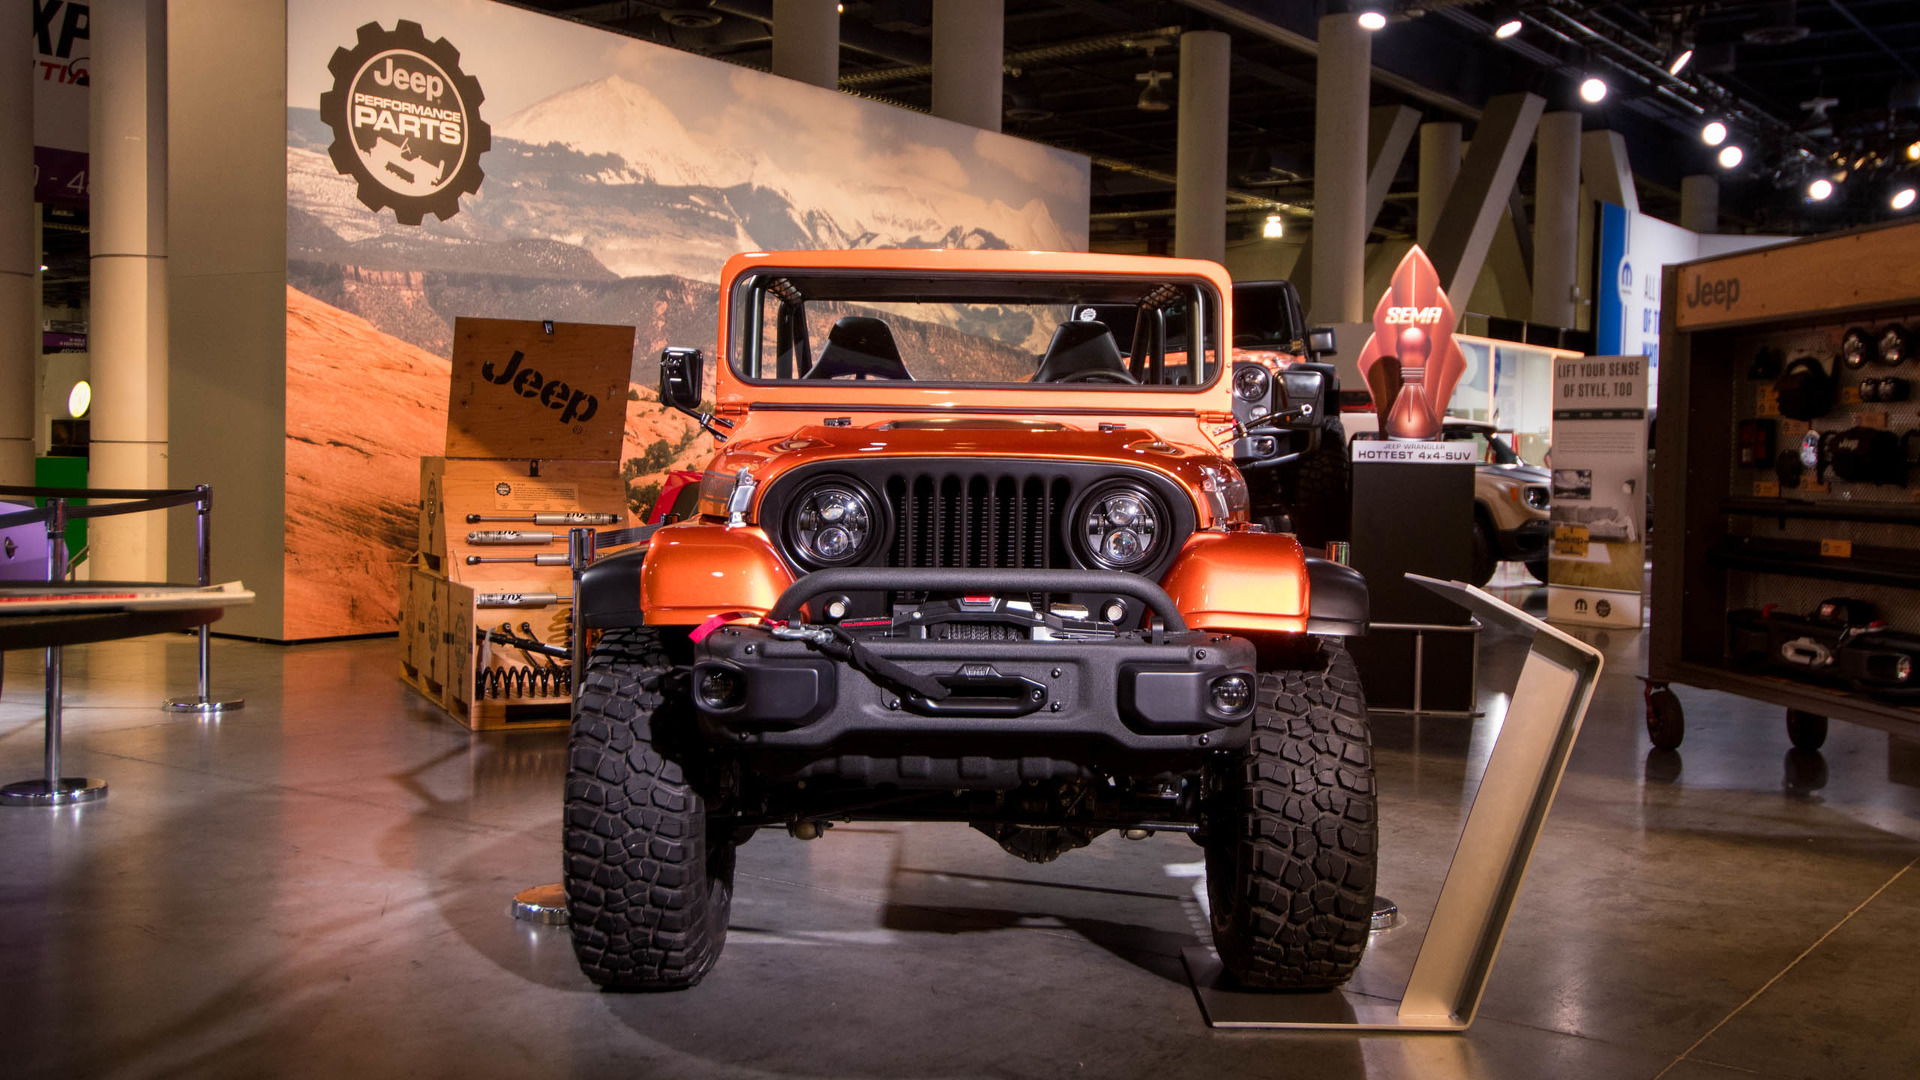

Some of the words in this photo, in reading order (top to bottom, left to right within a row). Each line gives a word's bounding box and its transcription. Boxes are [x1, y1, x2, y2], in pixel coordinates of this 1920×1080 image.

[374, 58, 444, 101] Jeep
[354, 92, 461, 123] PERFORMANCE
[354, 104, 461, 146] PARTS
[1686, 274, 1740, 311] Jeep
[1384, 306, 1443, 325] SEMA
[1558, 364, 1577, 378] LIFT
[1580, 363, 1605, 377] YOUR
[1609, 361, 1640, 376] SENSE
[481, 350, 599, 425] Jeep
[1563, 383, 1576, 398] OF
[1578, 382, 1610, 398] STYLE,
[1614, 382, 1633, 396] TOO
[1358, 450, 1414, 460] HOTTEST
[1418, 451, 1471, 461] 4x4-SUV
[1403, 443, 1446, 451] WRANGLER
